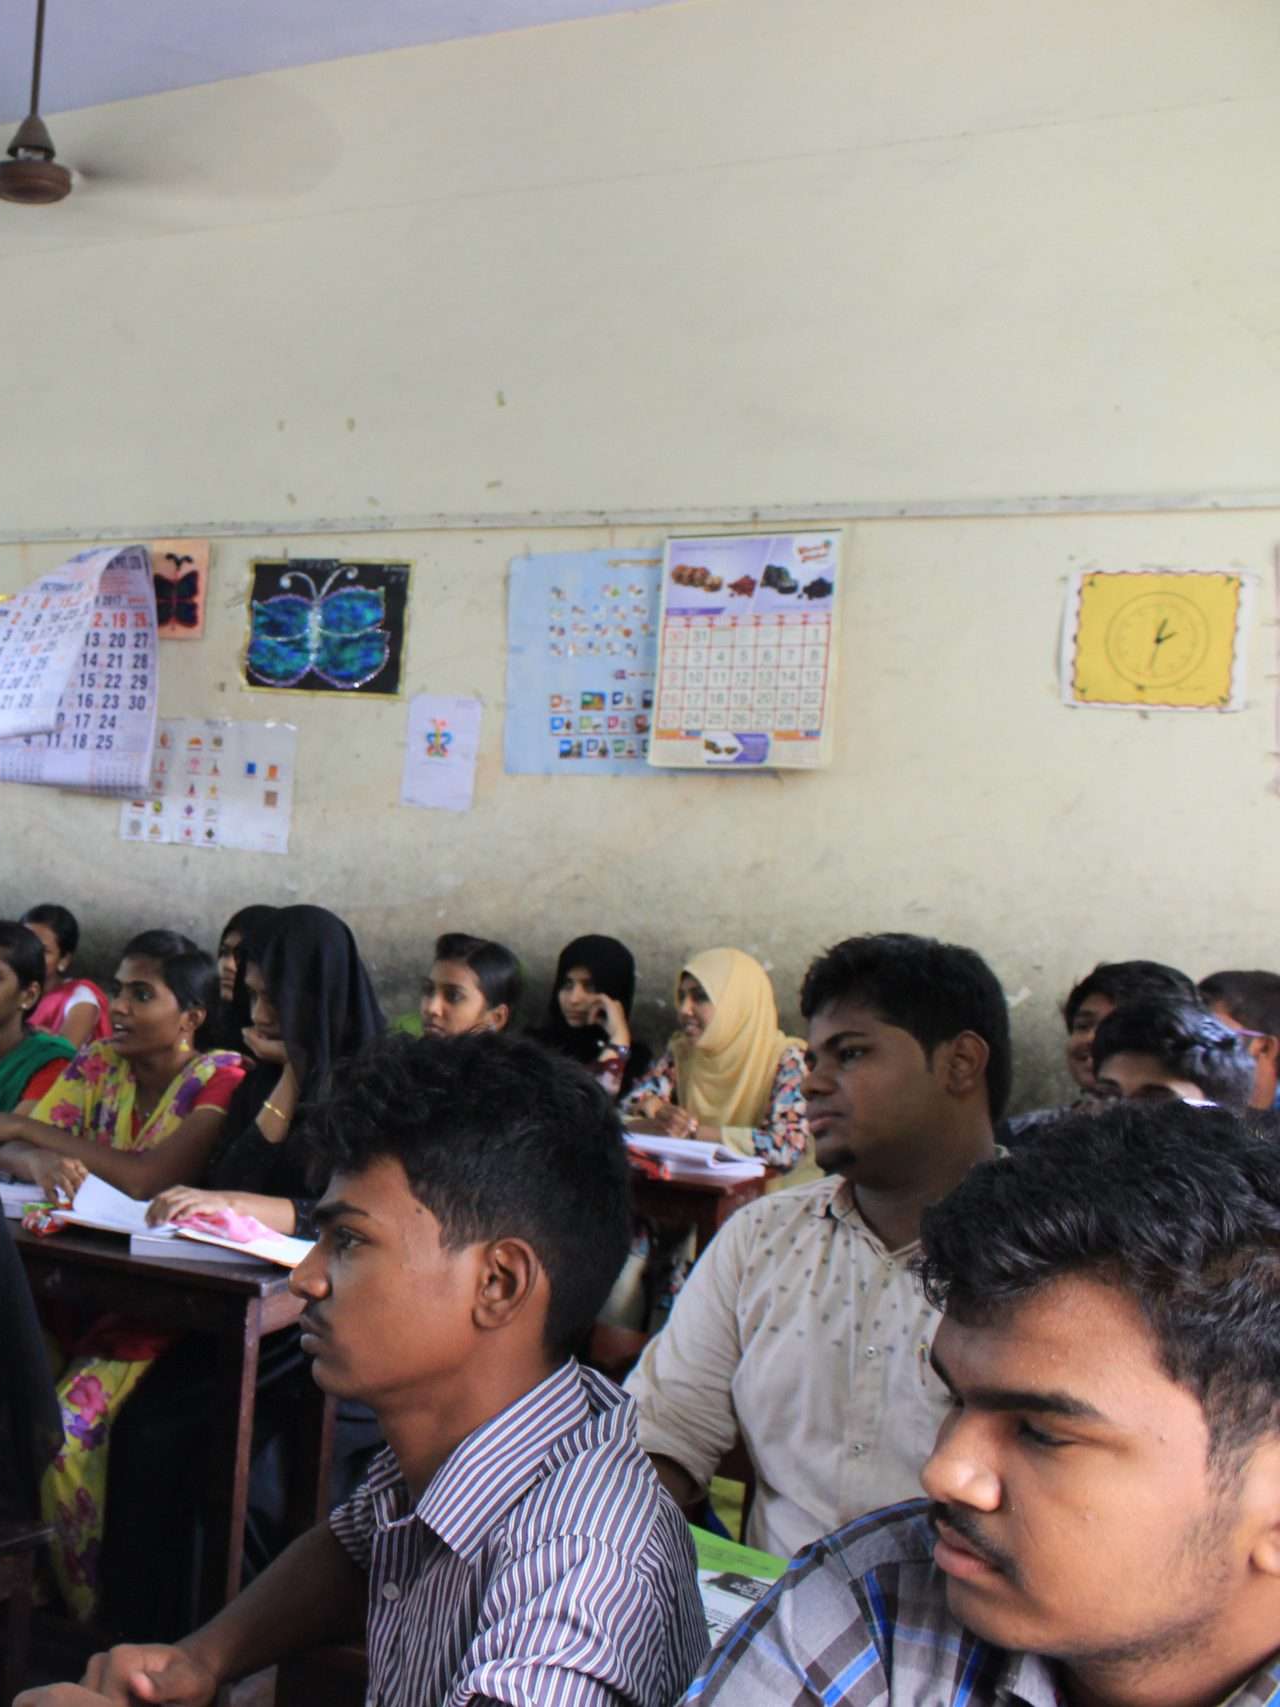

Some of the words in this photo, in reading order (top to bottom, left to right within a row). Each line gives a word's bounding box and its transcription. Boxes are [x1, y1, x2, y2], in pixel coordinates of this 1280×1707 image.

[113, 612, 127, 628] 19
[85, 632, 100, 647] 13
[109, 632, 125, 648] 20
[133, 632, 148, 648] 27
[82, 653, 98, 667] 14
[107, 653, 123, 669] 21
[132, 653, 148, 669] 28
[80, 673, 96, 688] 15
[104, 674, 122, 689] 22
[131, 674, 148, 690] 29
[77, 693, 94, 708] 16
[102, 694, 120, 709] 23
[128, 695, 146, 710] 30
[75, 713, 91, 728] 17
[99, 714, 116, 729] 24
[47, 732, 61, 747] 11
[72, 733, 88, 749] 18
[95, 734, 113, 750] 25
